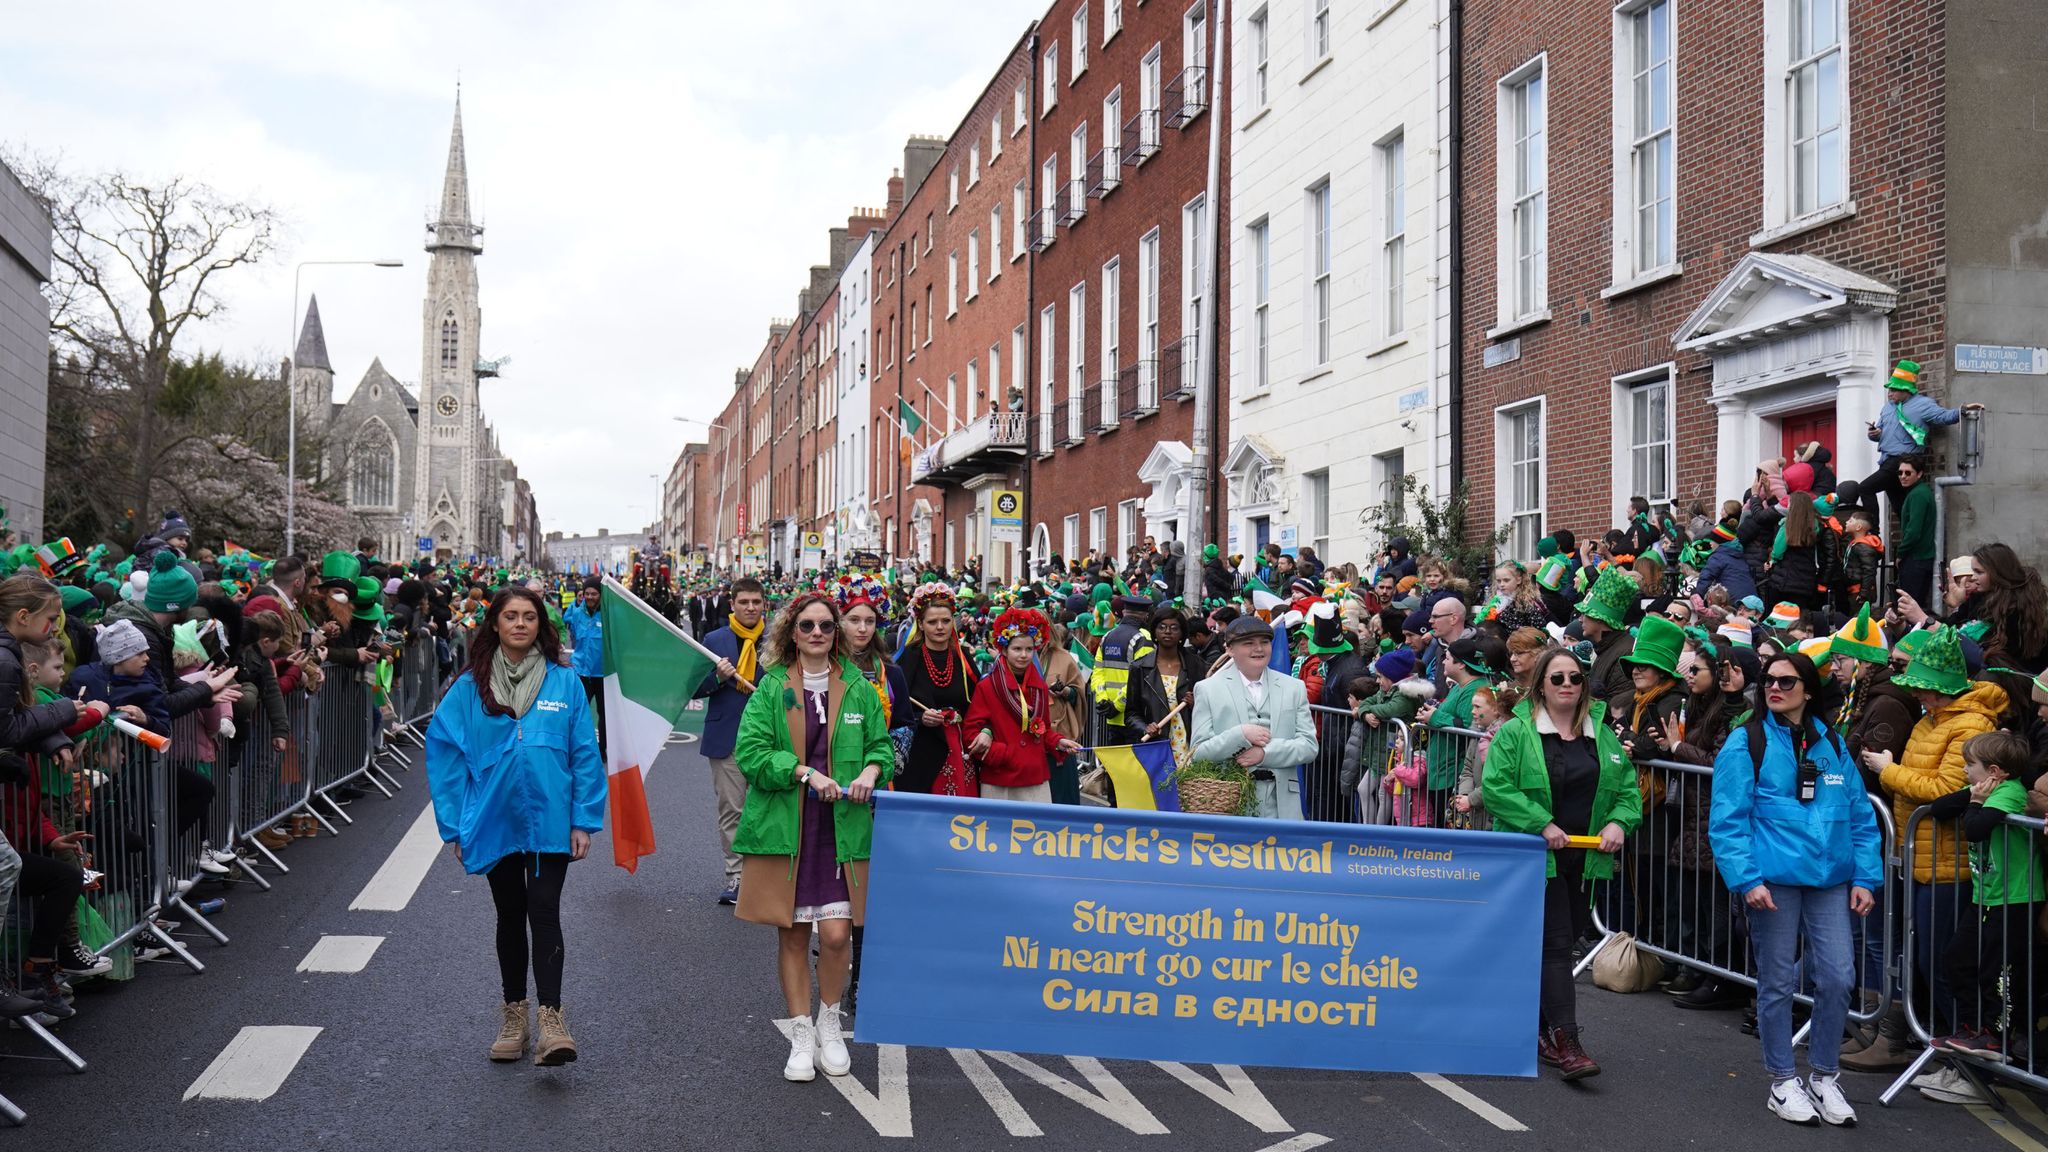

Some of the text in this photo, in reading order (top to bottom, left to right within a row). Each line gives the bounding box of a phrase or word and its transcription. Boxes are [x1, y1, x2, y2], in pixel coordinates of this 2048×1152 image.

[1989, 350, 2018, 360] RUTLAND
[1958, 359, 2031, 371] RUTLAND PLACE
[1105, 646, 1121, 656] GARDA
[949, 815, 1333, 874] St. Patrick's Festival
[1348, 844, 1453, 861] Dublin, Ireland
[1348, 862, 1480, 880] stpatricksfestival.ie
[1072, 900, 1360, 955] Strength in Unity
[1003, 935, 1418, 989] Ní neart go cur le chéile
[1042, 979, 1377, 1028] Сила в єдності
